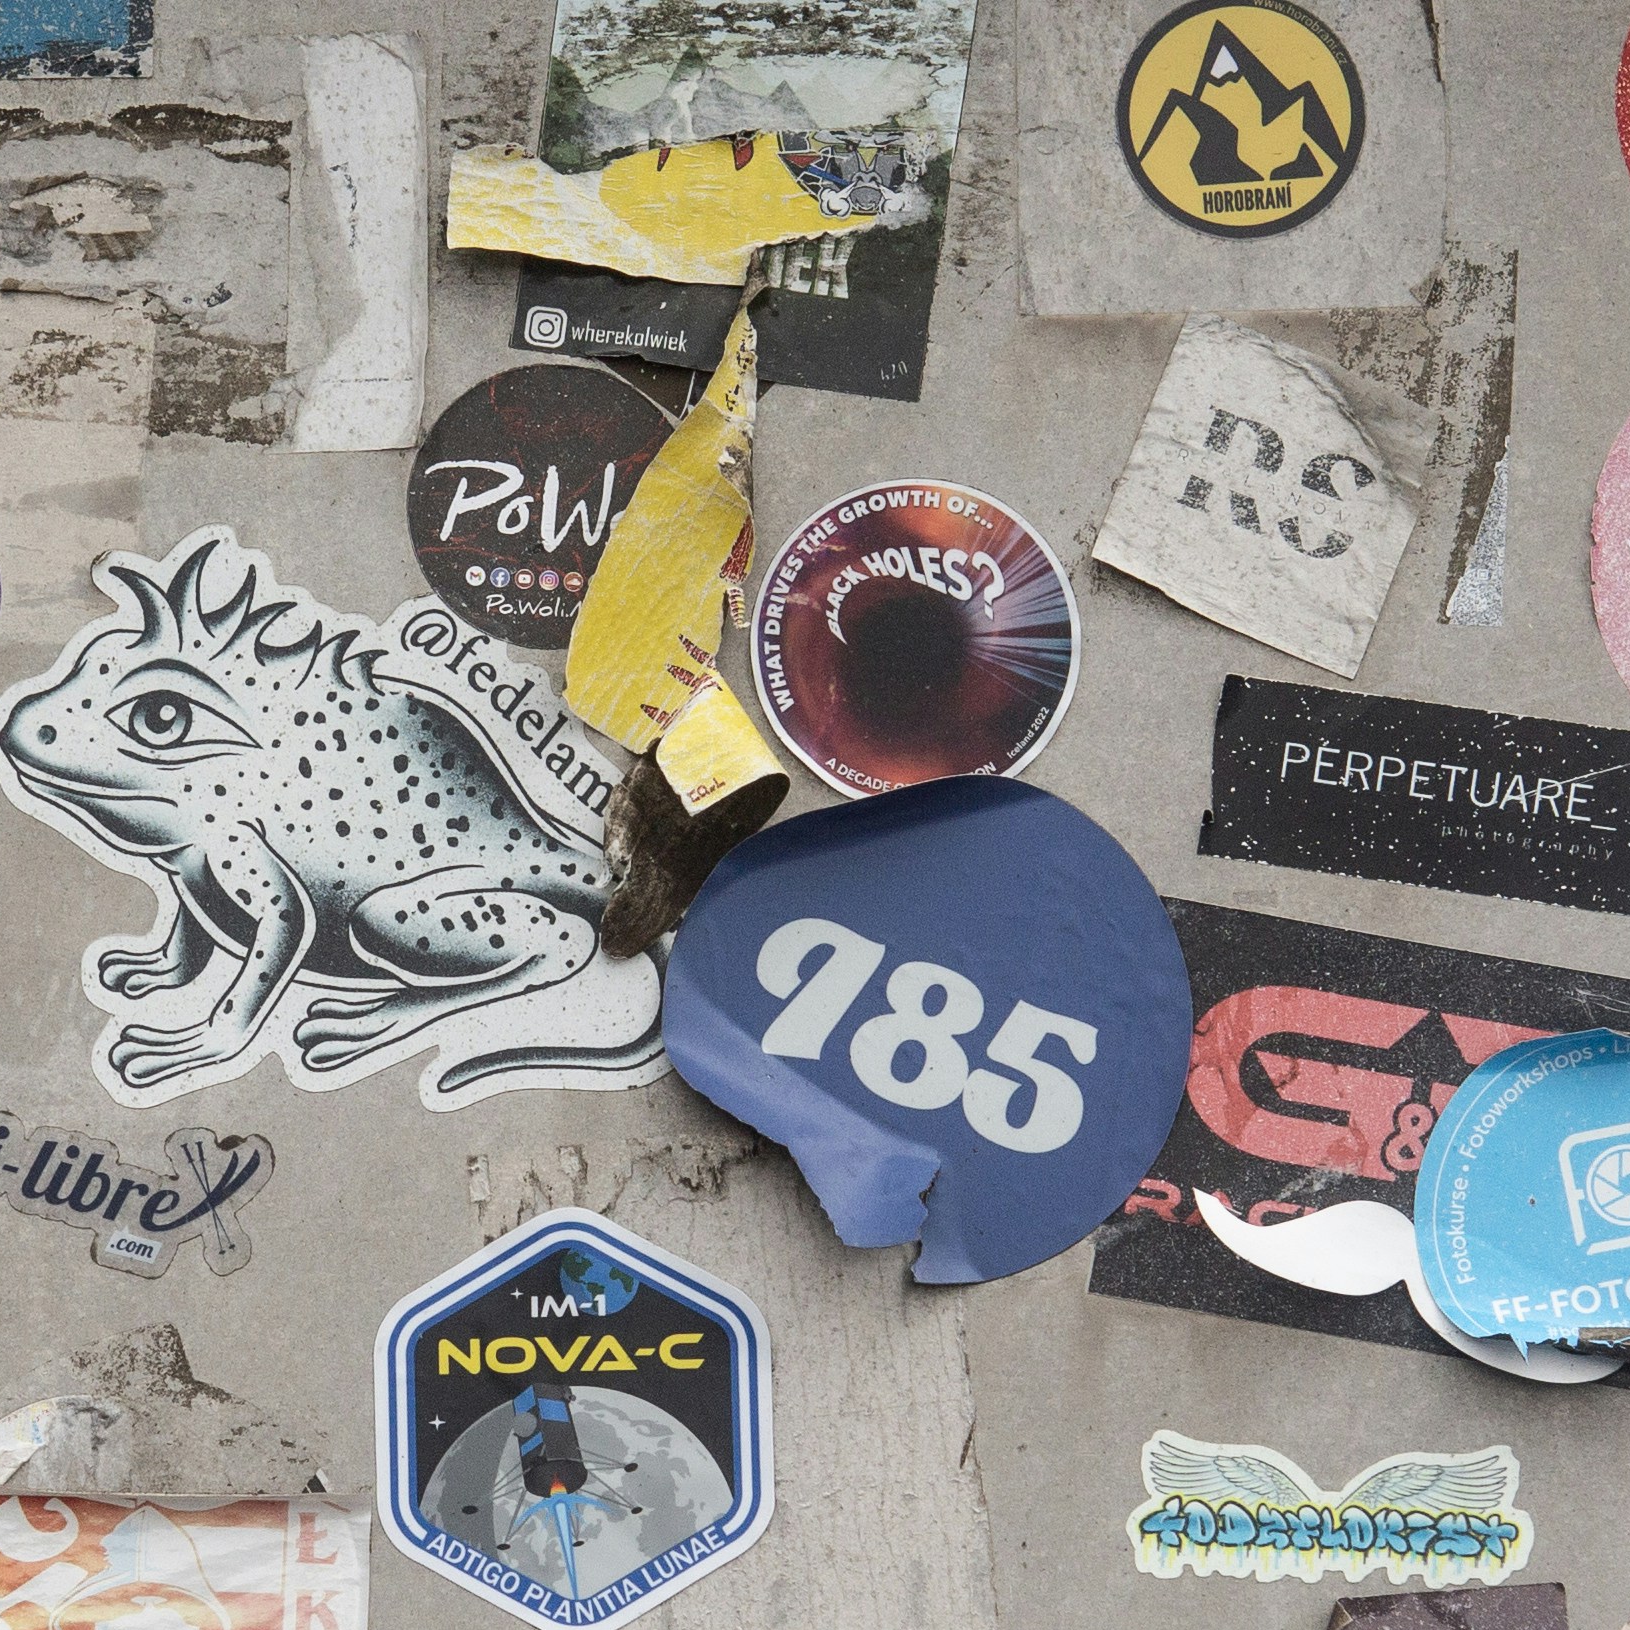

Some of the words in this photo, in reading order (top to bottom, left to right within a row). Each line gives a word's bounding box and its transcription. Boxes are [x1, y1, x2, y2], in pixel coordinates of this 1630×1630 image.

[1202, 183, 1293, 213] HOROBRANÍ
[571, 320, 688, 353] wherekolwiek
[838, 489, 941, 525] GROWTH
[946, 494, 995, 531] OF...
[797, 515, 840, 558] THE
[762, 550, 806, 630] DRIVES
[826, 560, 864, 645] BLACK
[864, 546, 1007, 620] HOLES?
[760, 633, 796, 713] WHAT
[1006, 726, 1035, 760] Iceland
[1028, 706, 1051, 733] 2022
[825, 756, 838, 771] A
[837, 762, 892, 793] DECADE
[1448, 1174, 1476, 1284] Fotokurse
[1462, 1044, 1593, 1159] Fotoworkshops
[109, 1236, 157, 1259] .com
[531, 1294, 606, 1318] IM-1
[438, 1333, 705, 1375] NOVA-C
[427, 1533, 521, 1593] ADTIGO
[522, 1577, 643, 1625] PLANITIA
[646, 1526, 726, 1586] LUNAE
